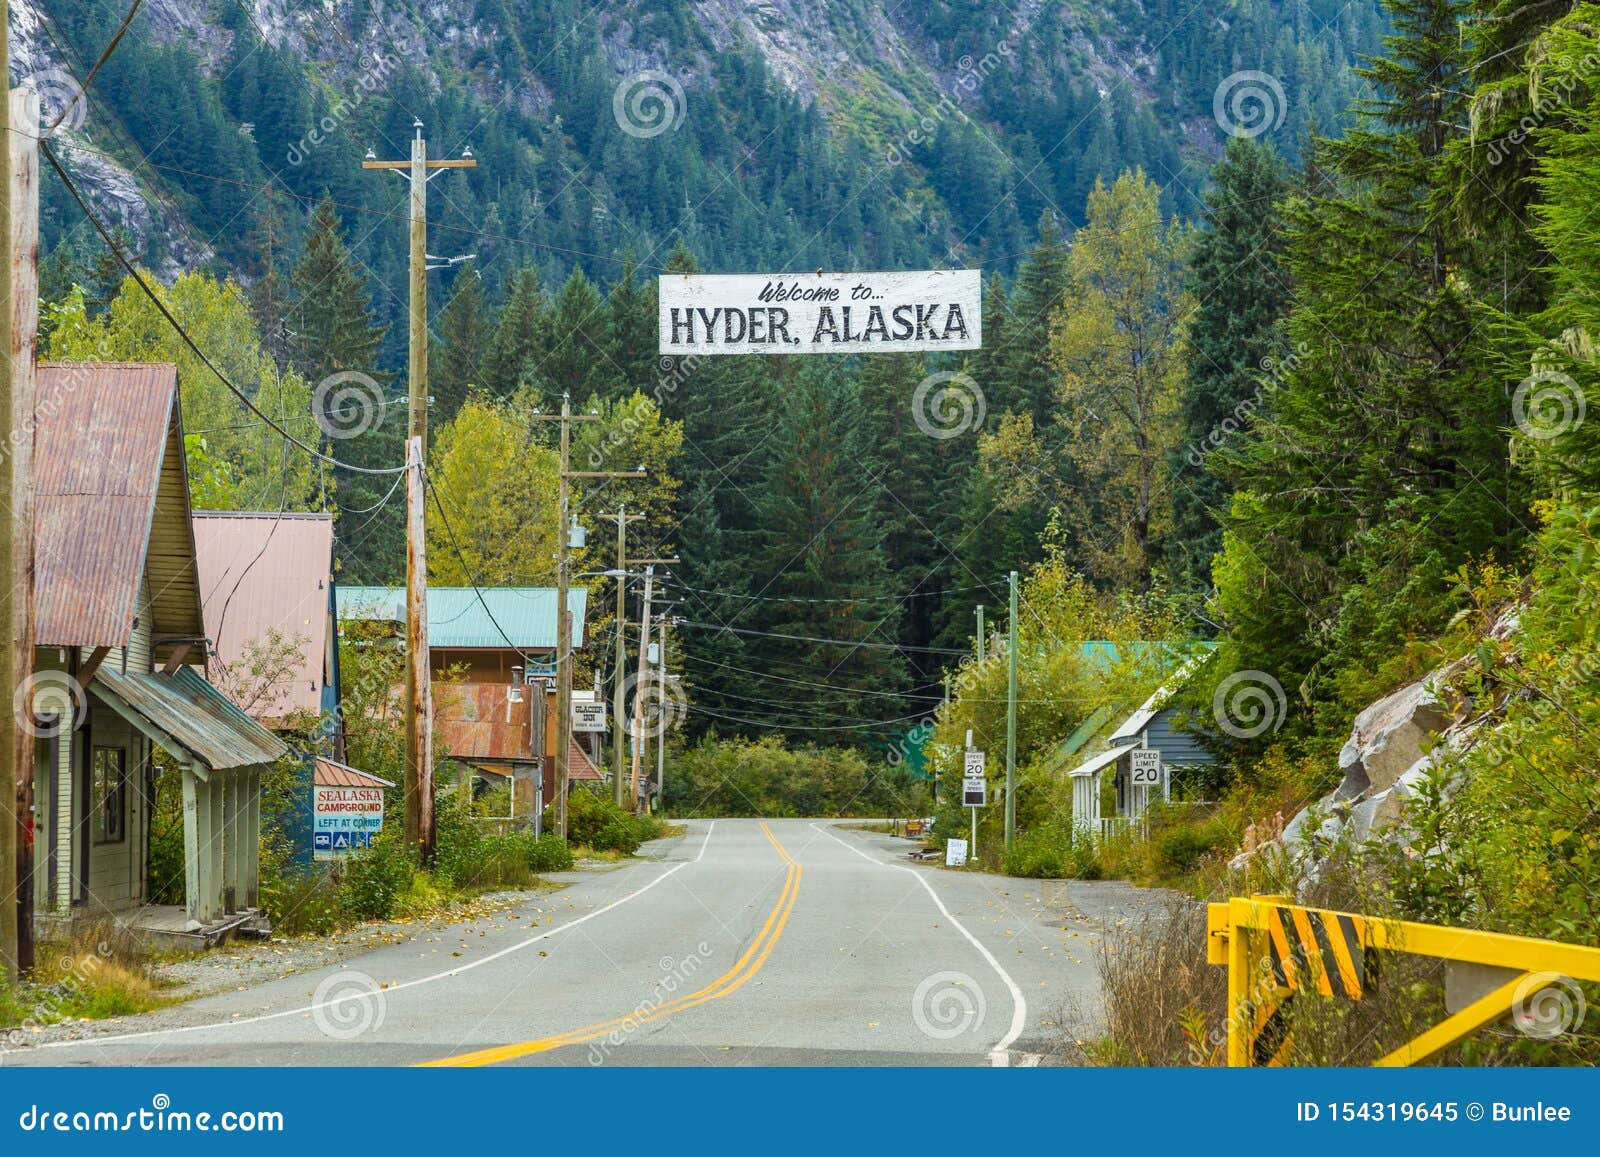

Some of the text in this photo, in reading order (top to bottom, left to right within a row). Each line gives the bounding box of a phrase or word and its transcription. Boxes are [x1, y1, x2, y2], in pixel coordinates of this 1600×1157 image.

[757, 281, 884, 303] Welcome to...
[670, 303, 970, 345] HYDER, ALASKA
[1134, 752, 1158, 760] SPEED
[967, 765, 983, 774] 20
[1134, 768, 1158, 781] 20
[319, 790, 381, 801] SEALASKA
[317, 803, 381, 812] CAMPGROUND
[319, 818, 338, 828] LEFT
[341, 818, 351, 828] AT
